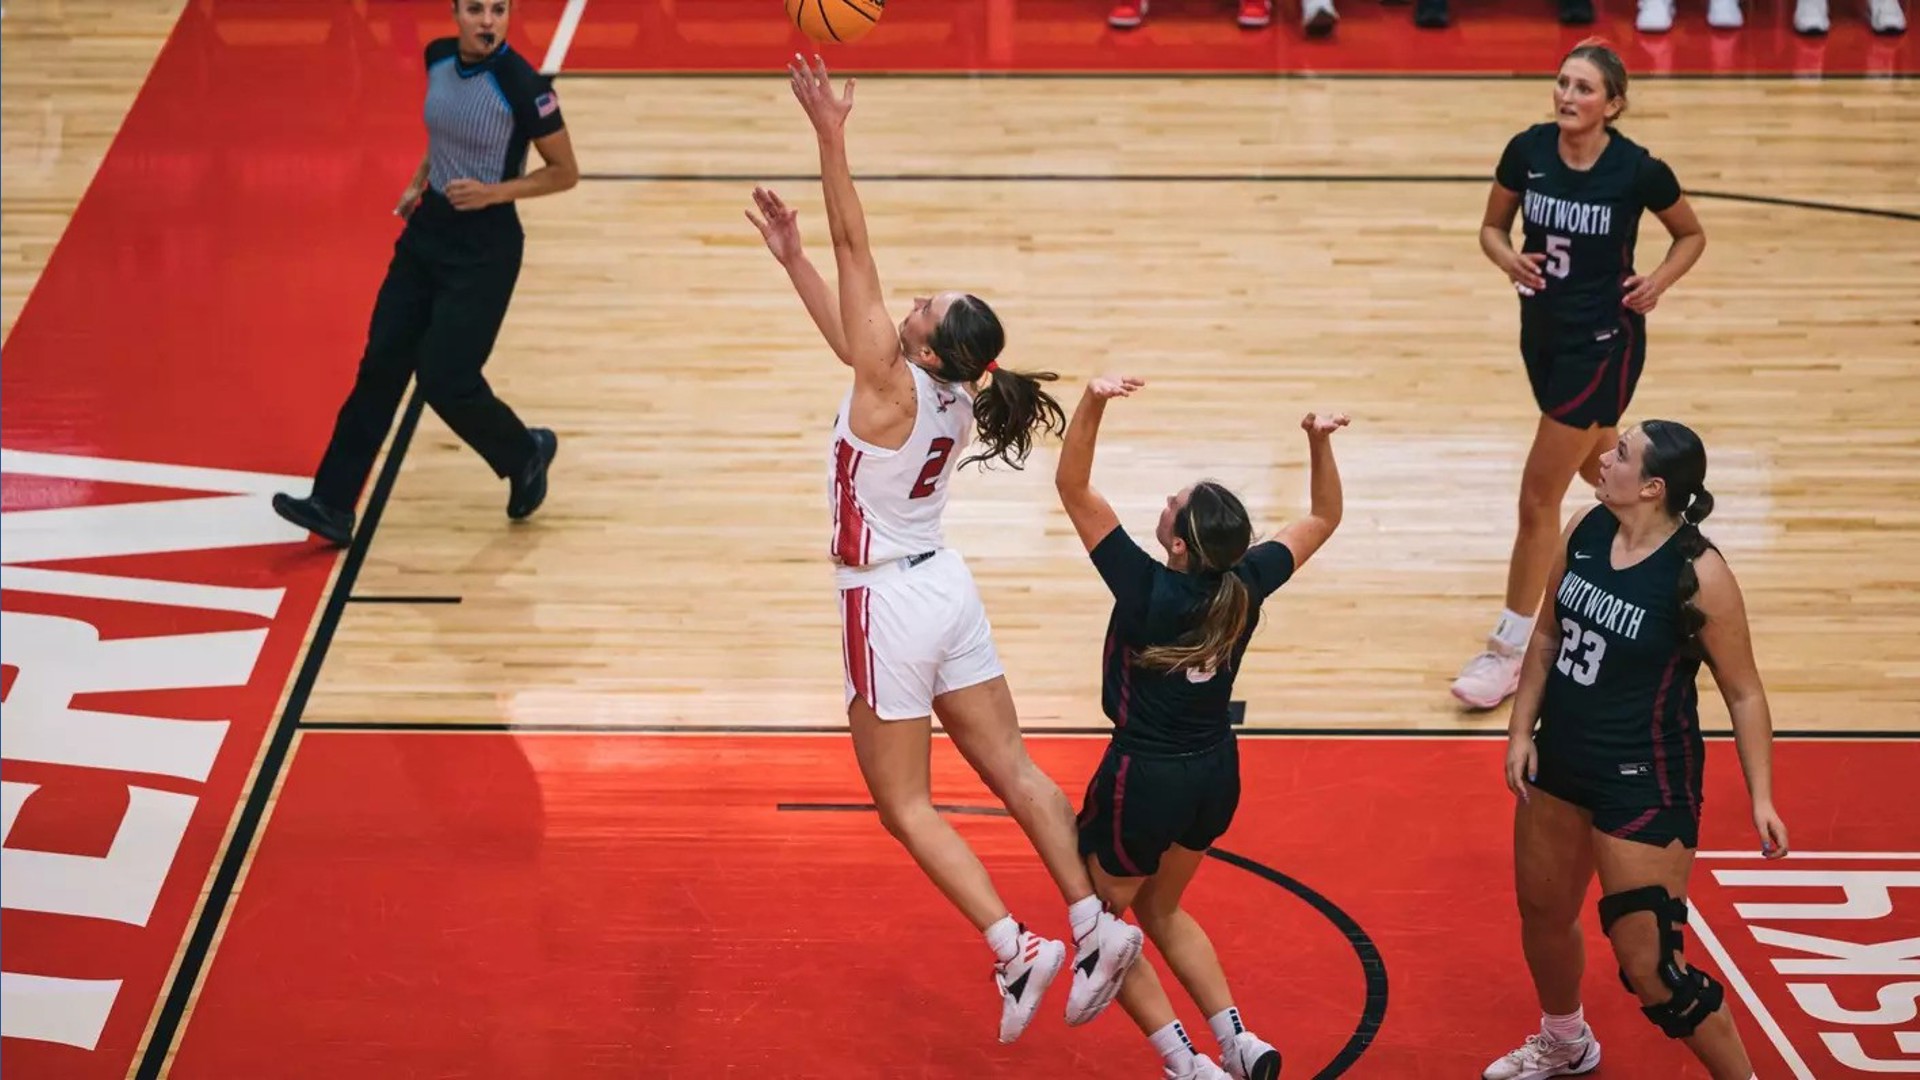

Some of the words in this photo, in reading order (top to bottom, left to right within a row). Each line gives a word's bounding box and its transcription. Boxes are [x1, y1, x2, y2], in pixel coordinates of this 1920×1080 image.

[1524, 189, 1611, 235] WHITWORTH
[1545, 236, 1571, 279] 5
[909, 436, 955, 500] 2
[1557, 570, 1646, 640] WHITWORTH
[1556, 617, 1607, 687] 23
